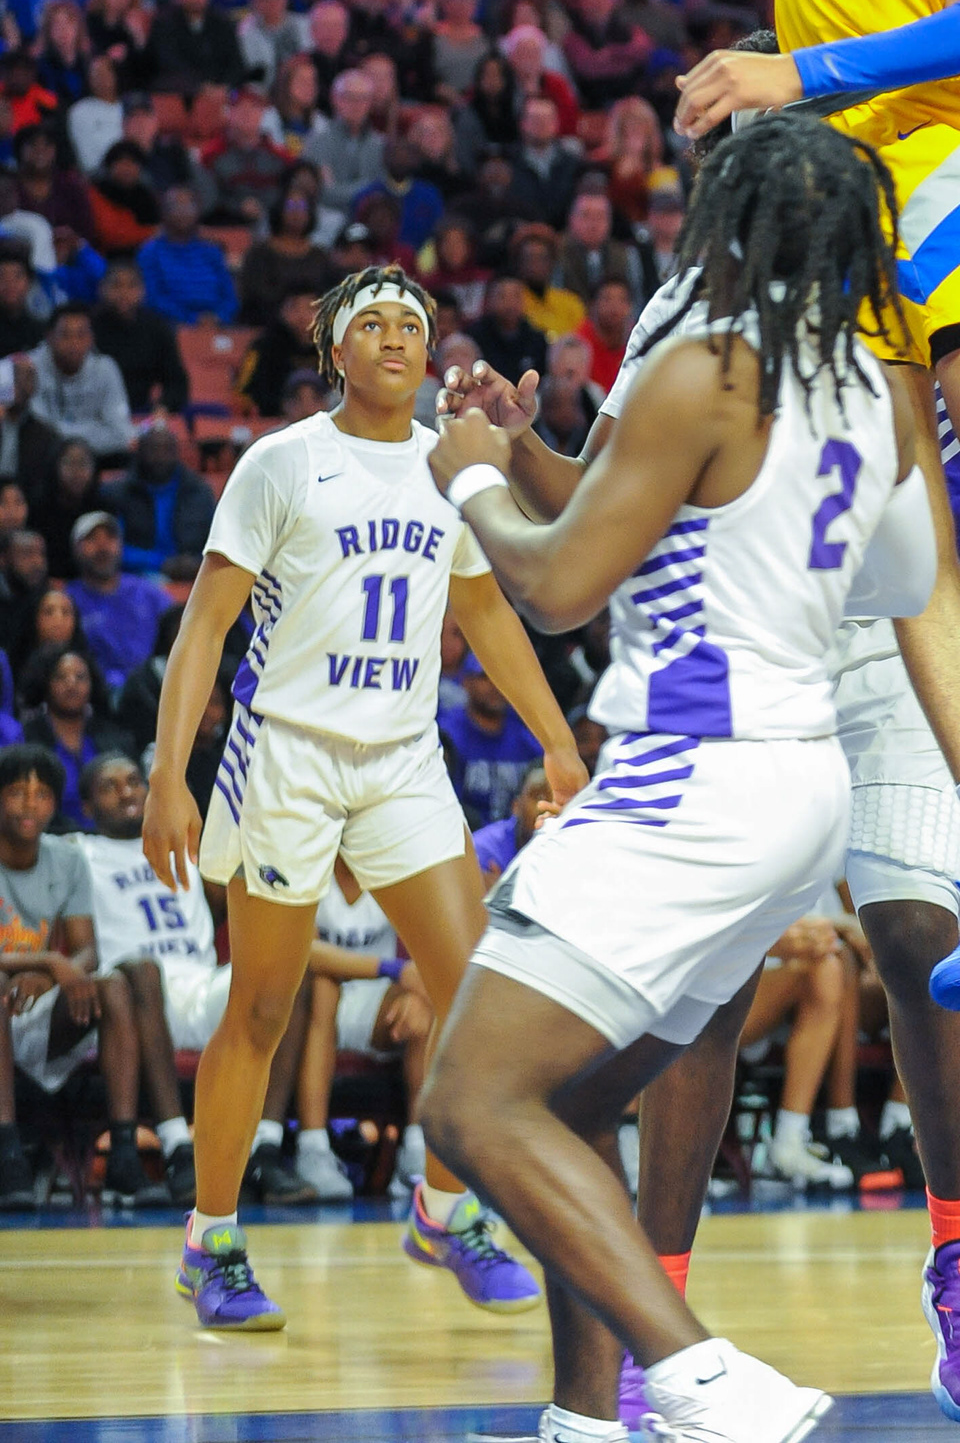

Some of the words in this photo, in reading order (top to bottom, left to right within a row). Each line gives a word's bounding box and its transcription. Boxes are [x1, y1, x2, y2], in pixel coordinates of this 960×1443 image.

[808, 437, 863, 569] 2
[334, 518, 445, 563] RIDGE
[360, 573, 409, 644] 11
[327, 652, 420, 691] VIEW
[138, 894, 187, 932] 15
